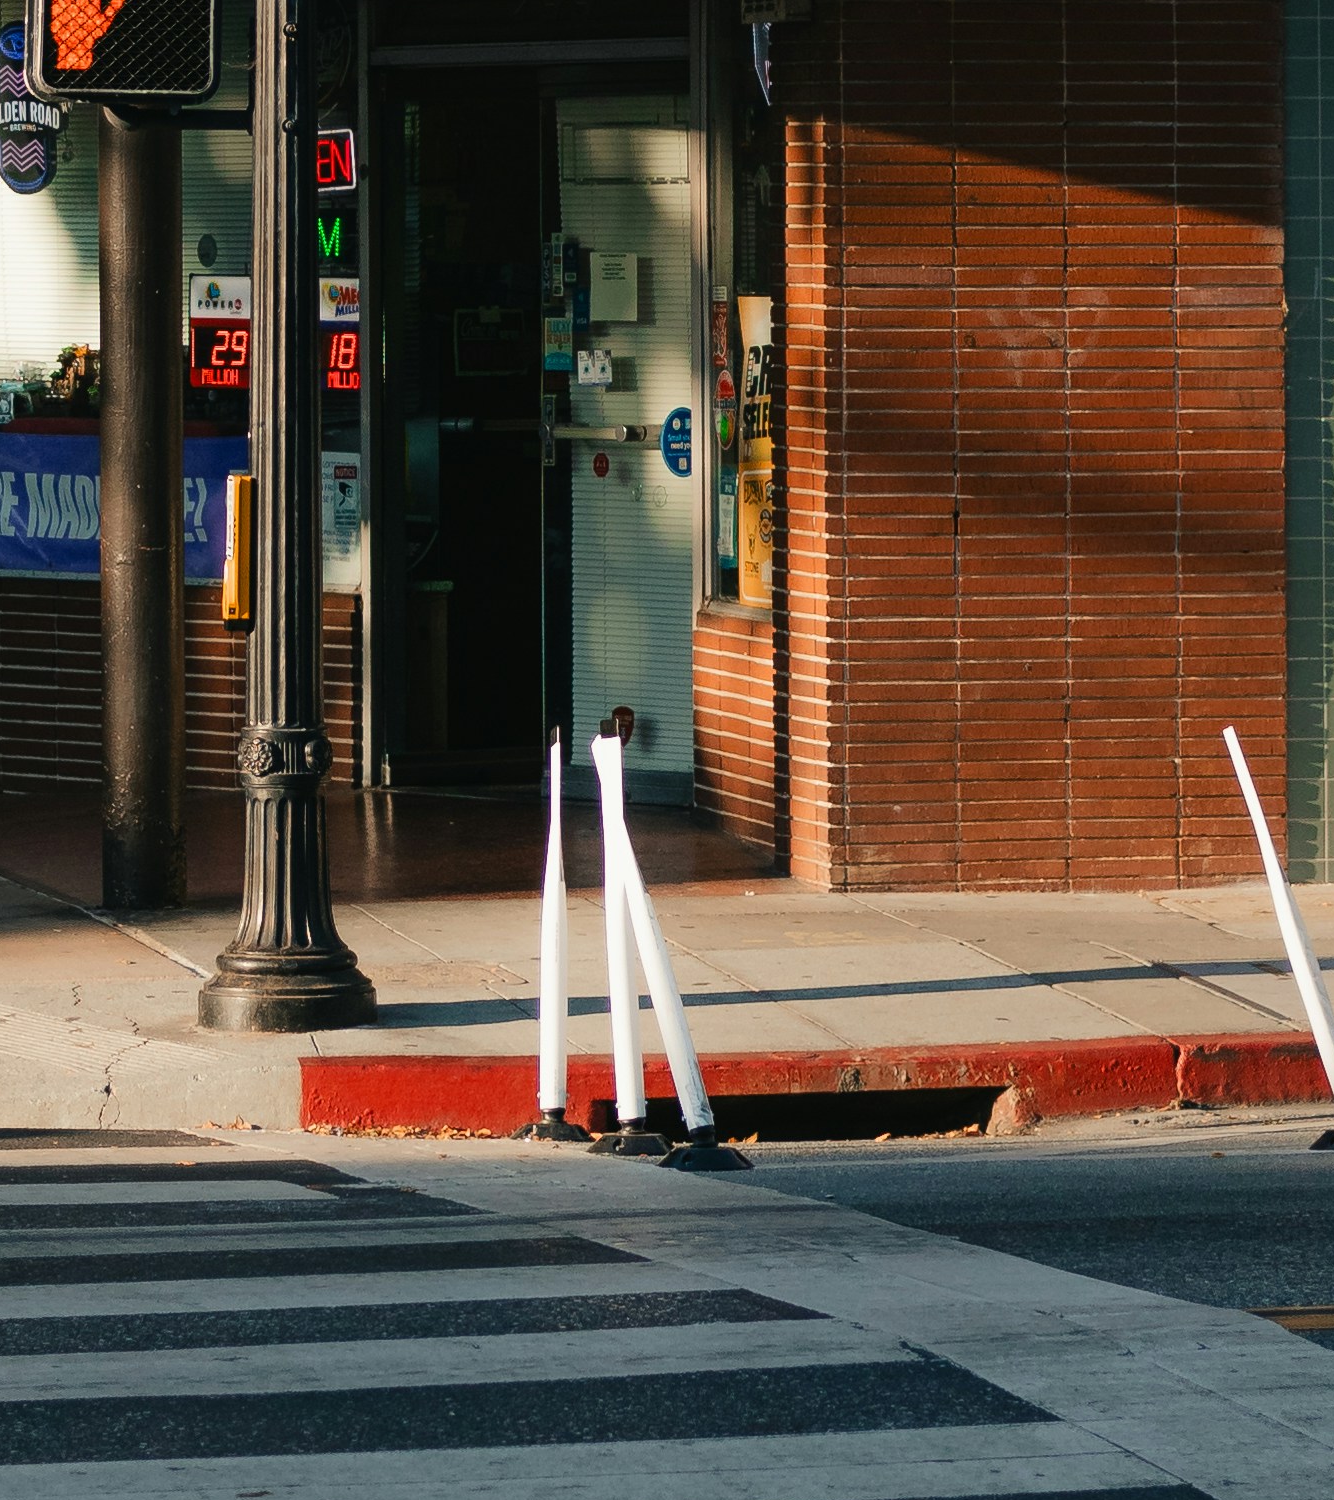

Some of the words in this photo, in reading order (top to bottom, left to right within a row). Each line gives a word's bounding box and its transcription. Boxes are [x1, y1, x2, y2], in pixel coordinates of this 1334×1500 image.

[9, 123, 37, 132] BREWING
[30, 101, 60, 129] ROAD
[211, 331, 248, 367] 29
[329, 333, 357, 369] 18
[335, 468, 356, 478] NOTICE
[24, 473, 101, 539] MAD
